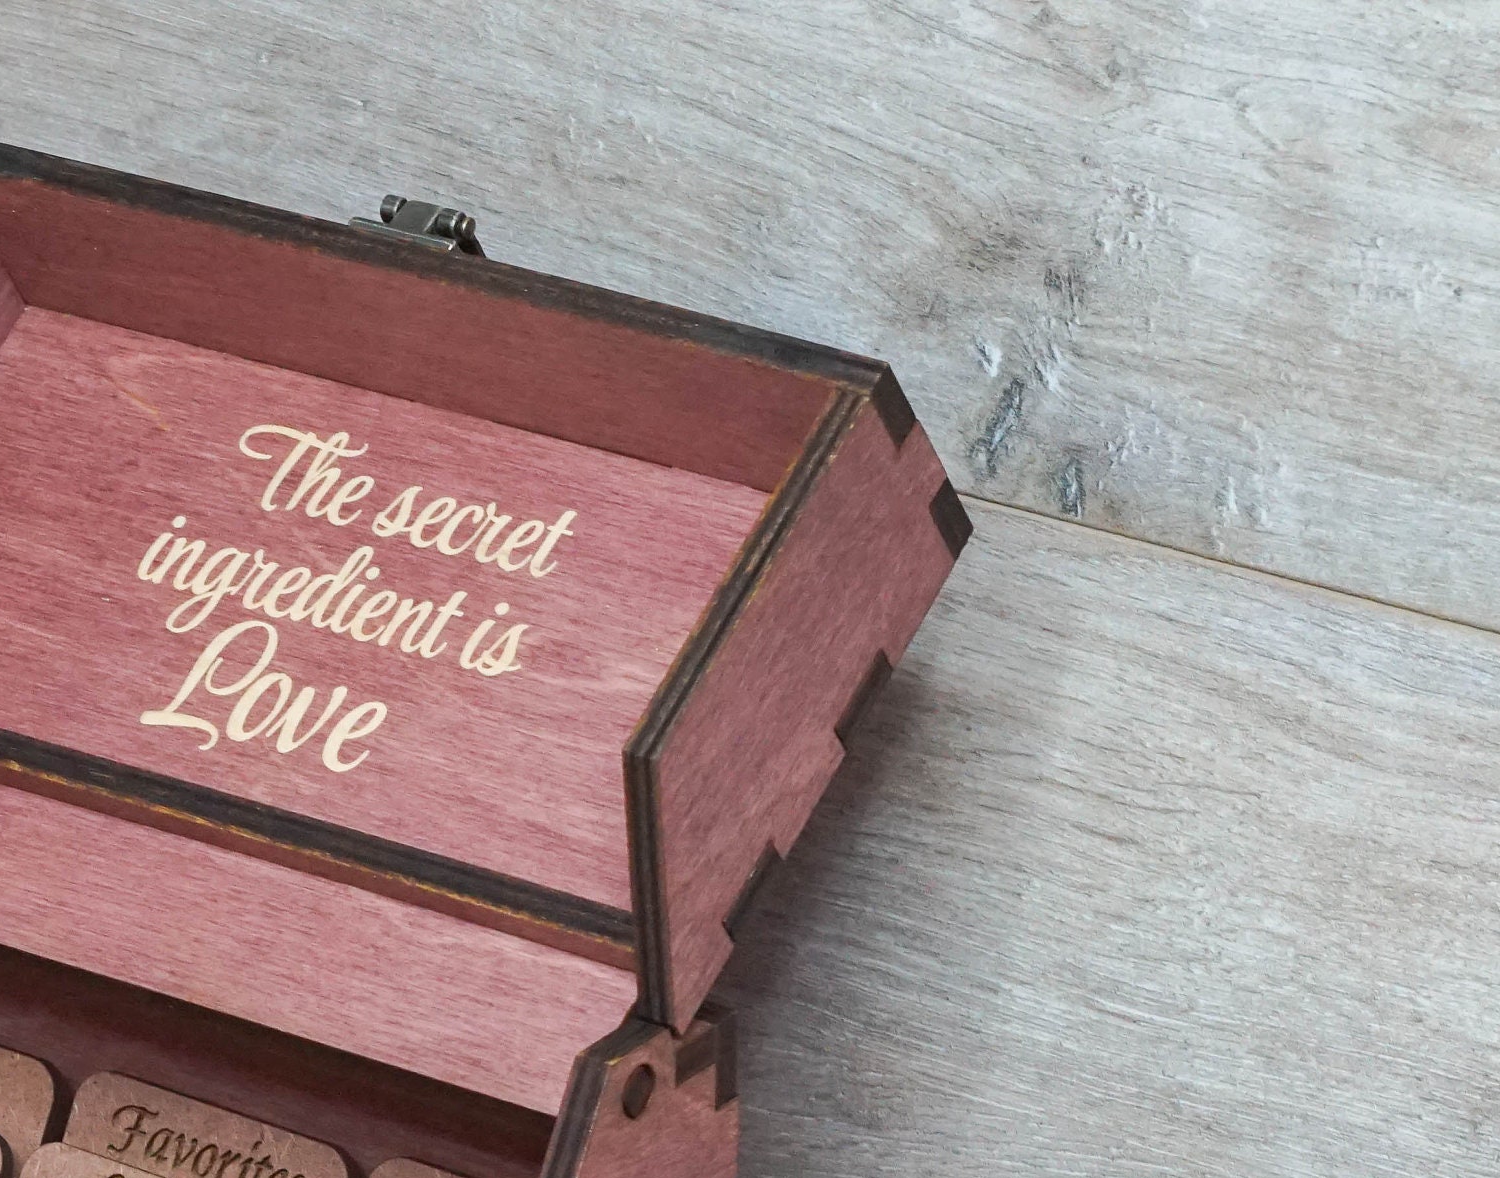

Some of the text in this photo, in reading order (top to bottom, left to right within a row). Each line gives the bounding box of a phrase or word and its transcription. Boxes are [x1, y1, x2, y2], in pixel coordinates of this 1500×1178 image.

[239, 424, 577, 578] The secret
[137, 516, 529, 677] ingredient is
[140, 620, 388, 773] Love
